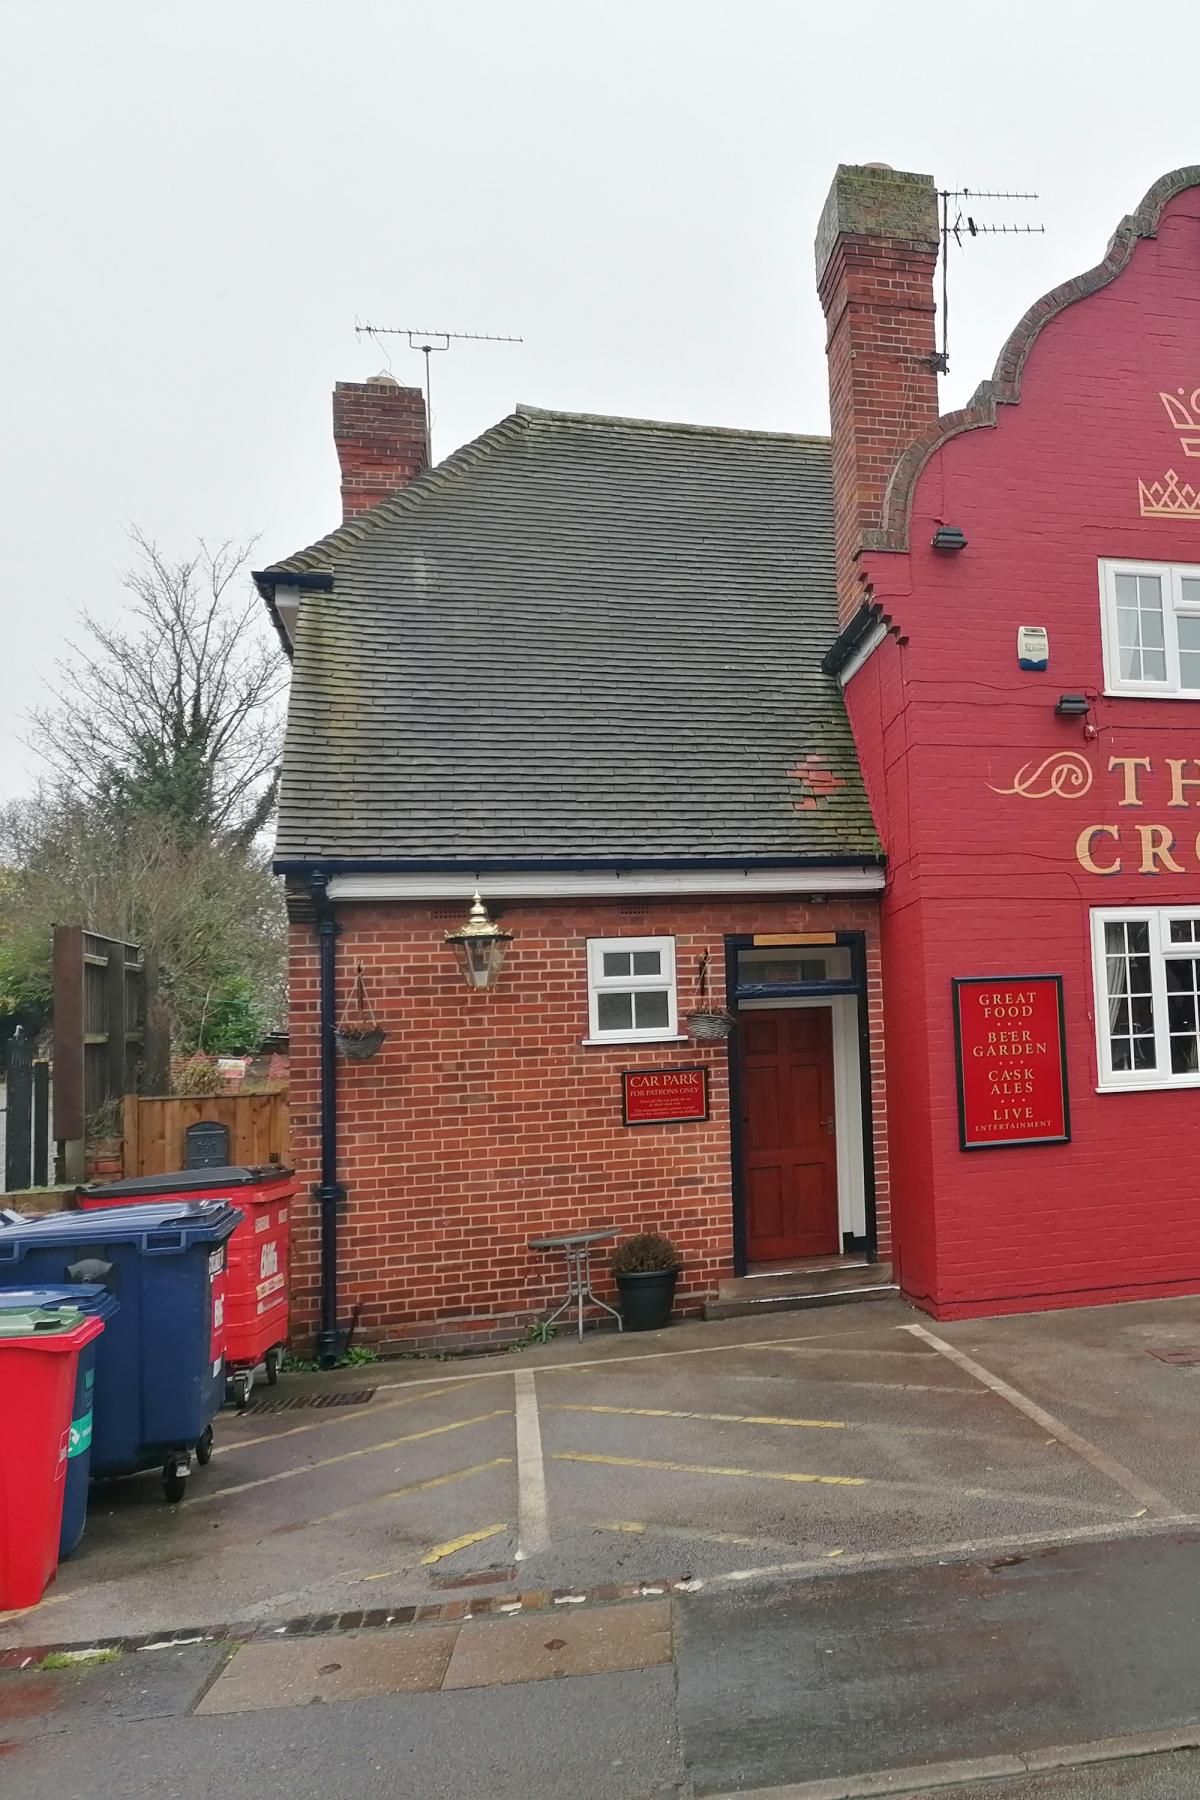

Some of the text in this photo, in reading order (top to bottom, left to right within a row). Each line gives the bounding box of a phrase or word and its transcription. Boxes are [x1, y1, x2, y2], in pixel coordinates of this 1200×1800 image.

[978, 992, 1037, 1006] GREAT
[984, 1006, 1033, 1019] FOOD
[988, 1031, 1032, 1043] BEER
[972, 1042, 1048, 1057] GARDEN
[630, 1074, 698, 1087] CAR PARK
[988, 1068, 1035, 1082] CASK
[990, 1081, 1034, 1095] ALES
[993, 1107, 1034, 1121] LIVE
[975, 1120, 1053, 1132] ENTERTAINMENT
